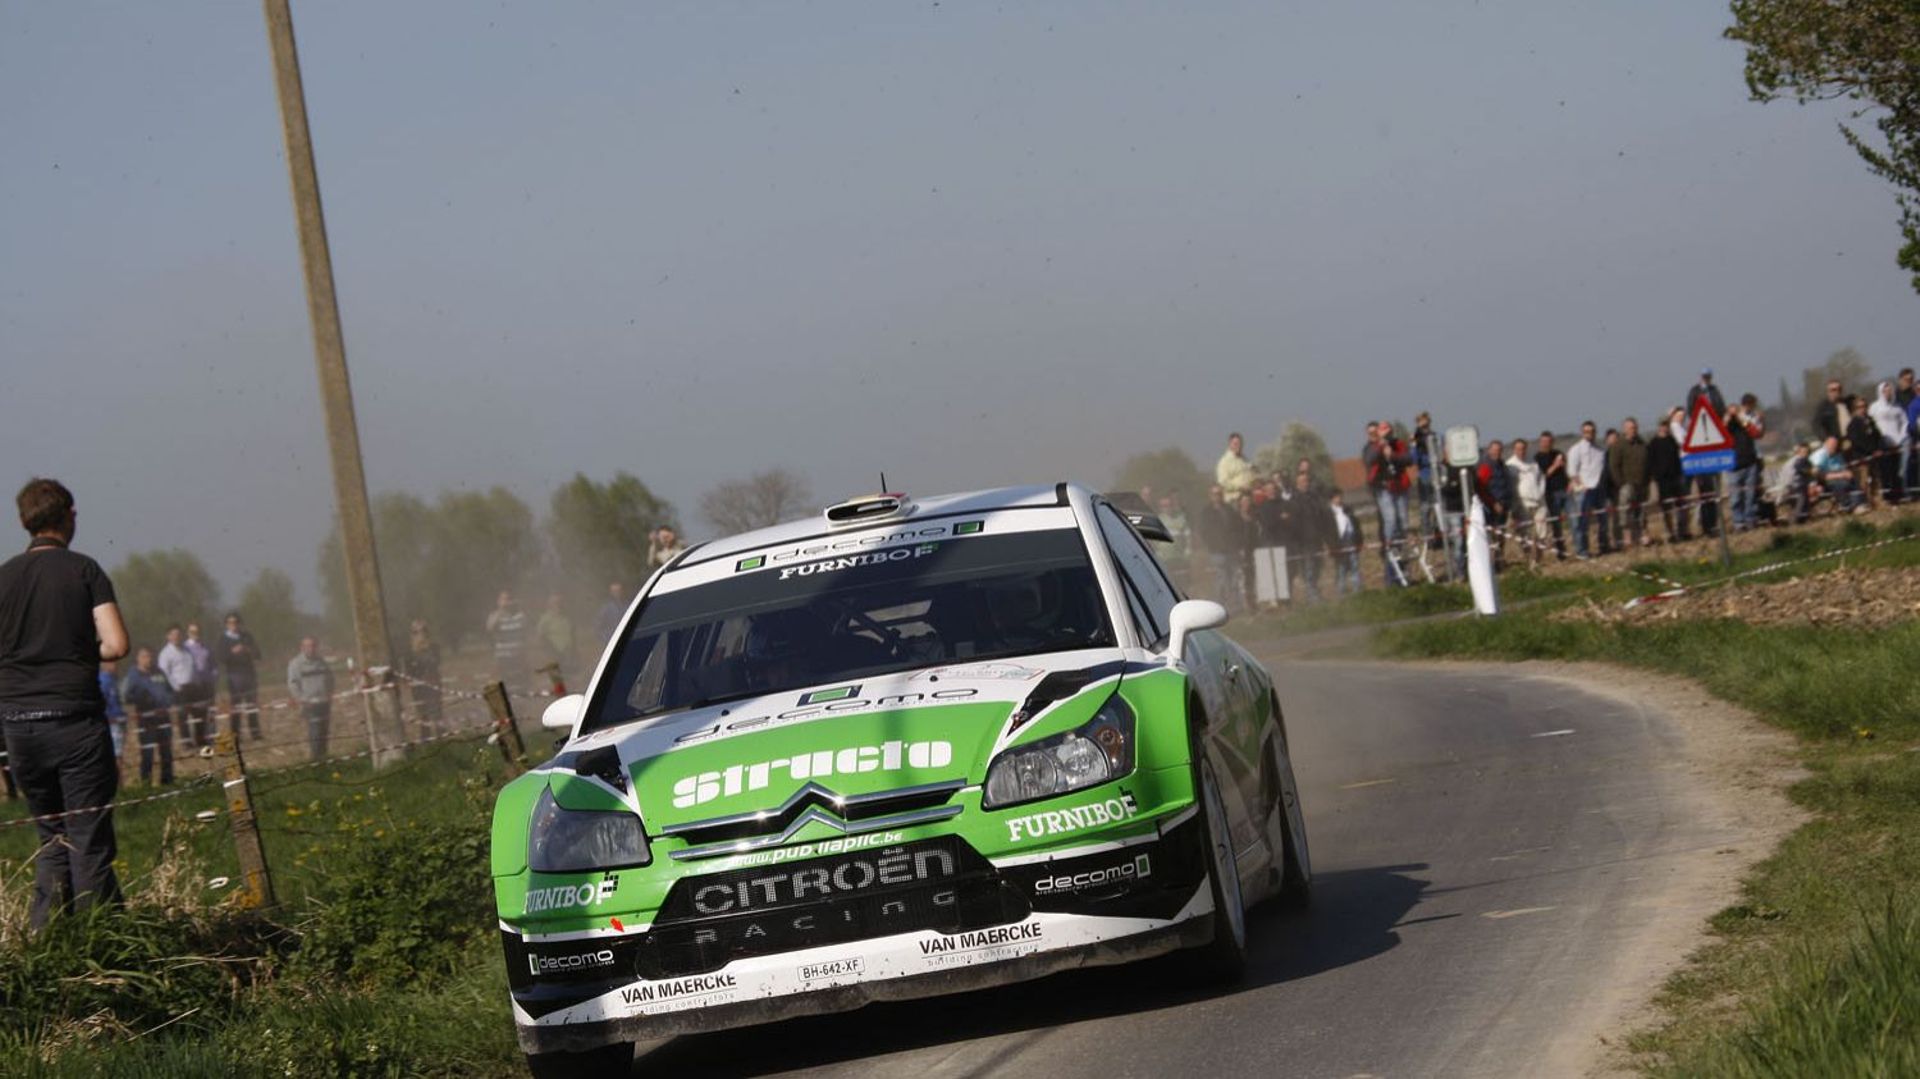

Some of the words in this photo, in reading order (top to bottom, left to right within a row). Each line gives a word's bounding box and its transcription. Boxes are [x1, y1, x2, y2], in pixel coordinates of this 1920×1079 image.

[673, 740, 952, 808] structo
[1035, 863, 1135, 891] decomo
[920, 937, 956, 954] VAN
[960, 922, 1042, 949] MAERCKE
[540, 950, 613, 969] decomo
[802, 958, 859, 979] BH-642-XF
[621, 985, 654, 1004] VAN
[658, 974, 737, 998] MAERCKE
